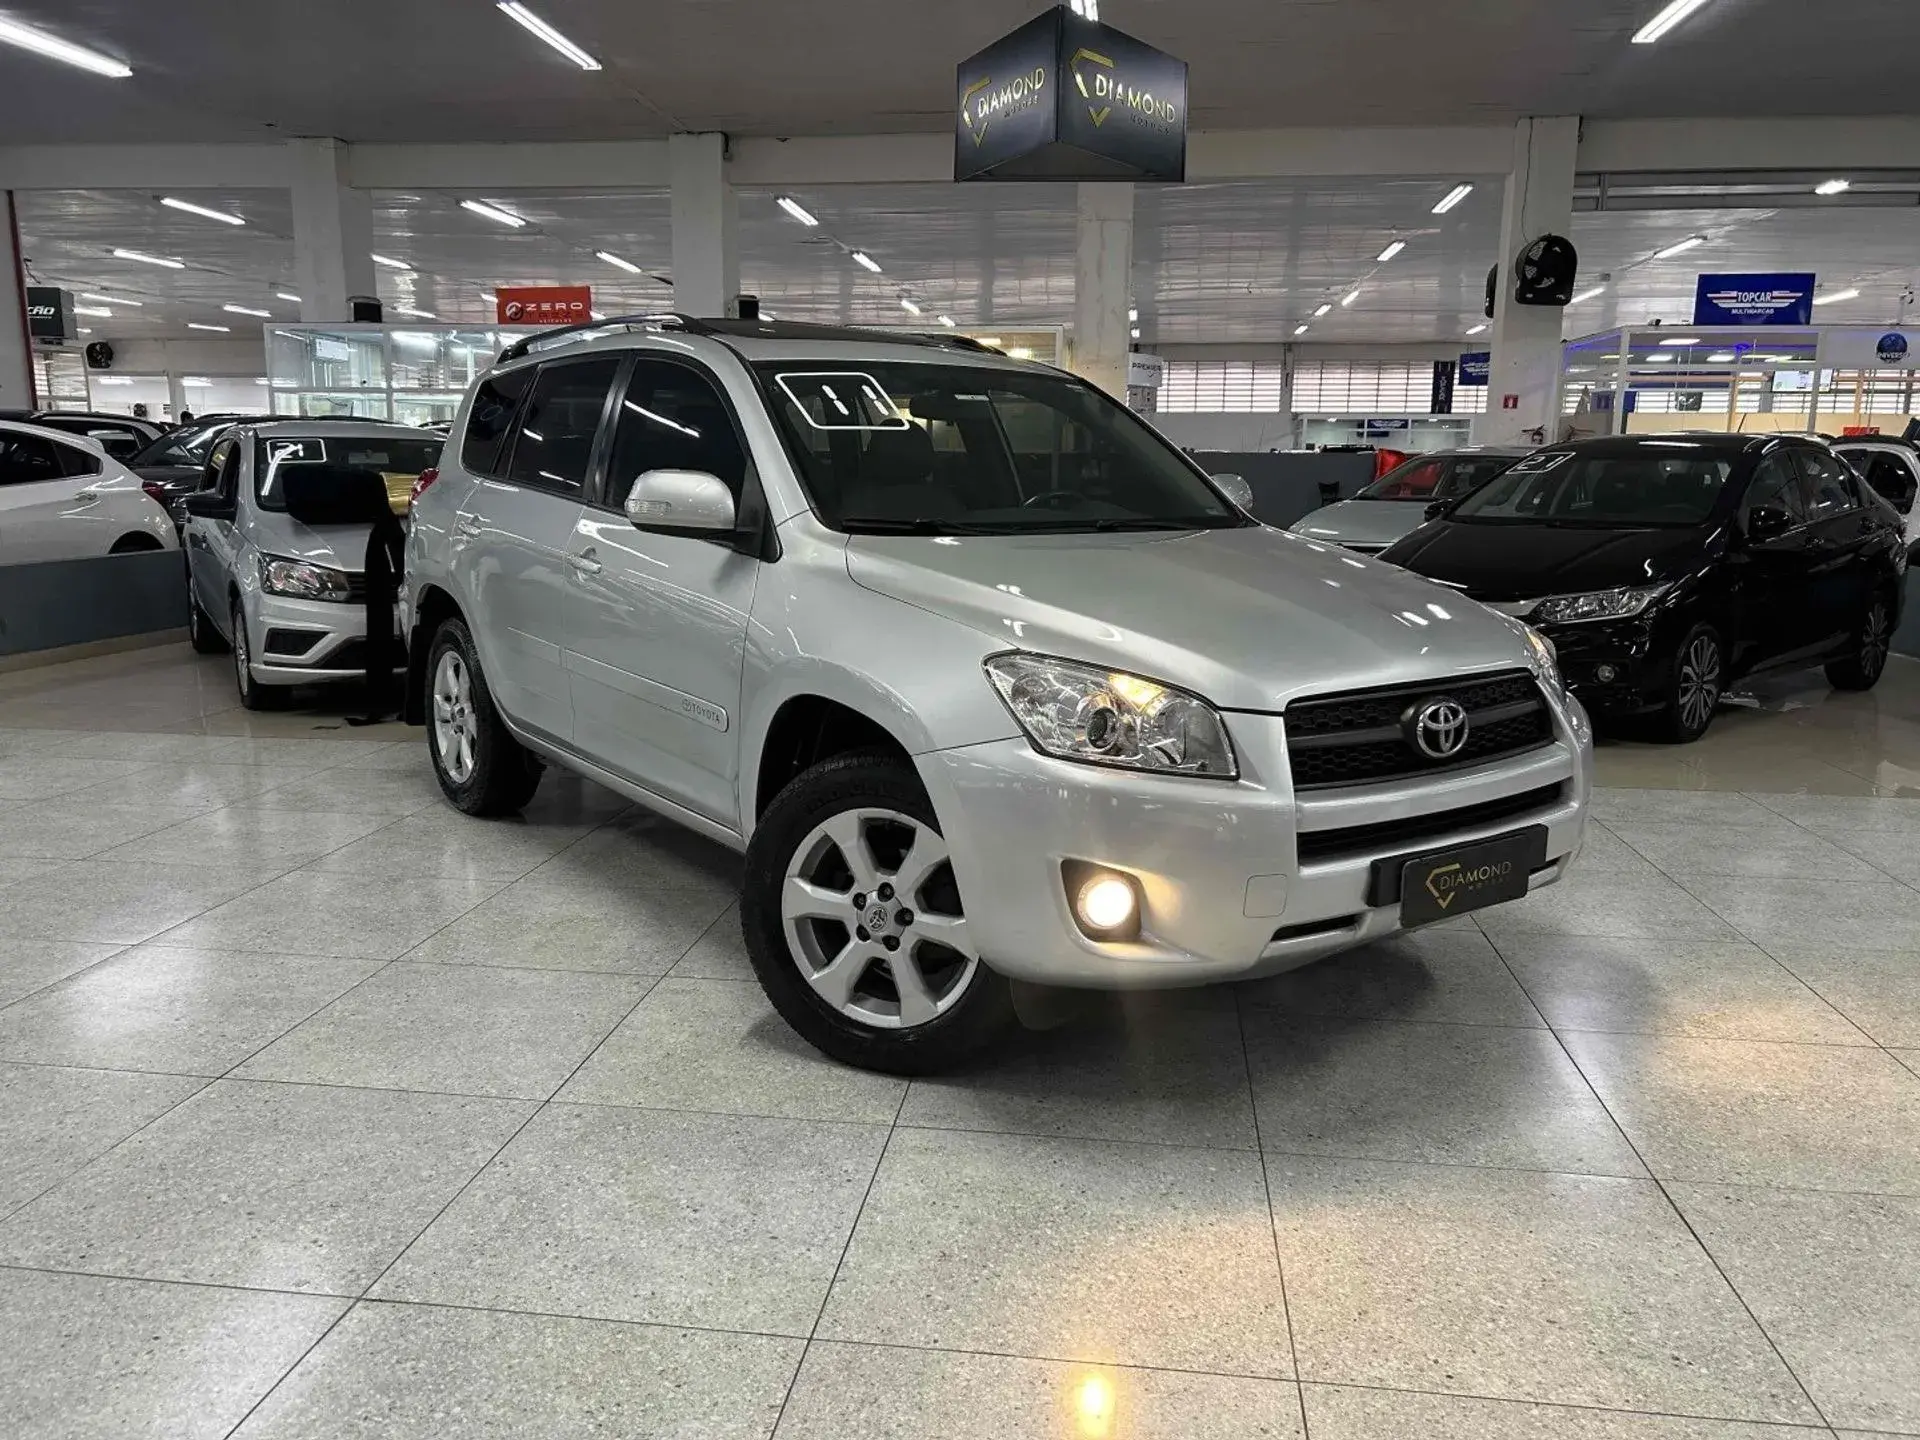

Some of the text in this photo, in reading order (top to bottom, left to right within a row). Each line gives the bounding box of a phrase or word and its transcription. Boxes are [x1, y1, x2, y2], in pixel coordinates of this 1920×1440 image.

[978, 68, 1045, 118] DIAMOND
[1095, 74, 1176, 123] DIAMOND
[526, 302, 583, 311] ZERO
[1737, 291, 1772, 302] TOPCAR
[1517, 456, 1564, 470] 21
[692, 702, 720, 724] TOYOTA
[1440, 861, 1512, 889] DIAMOND
